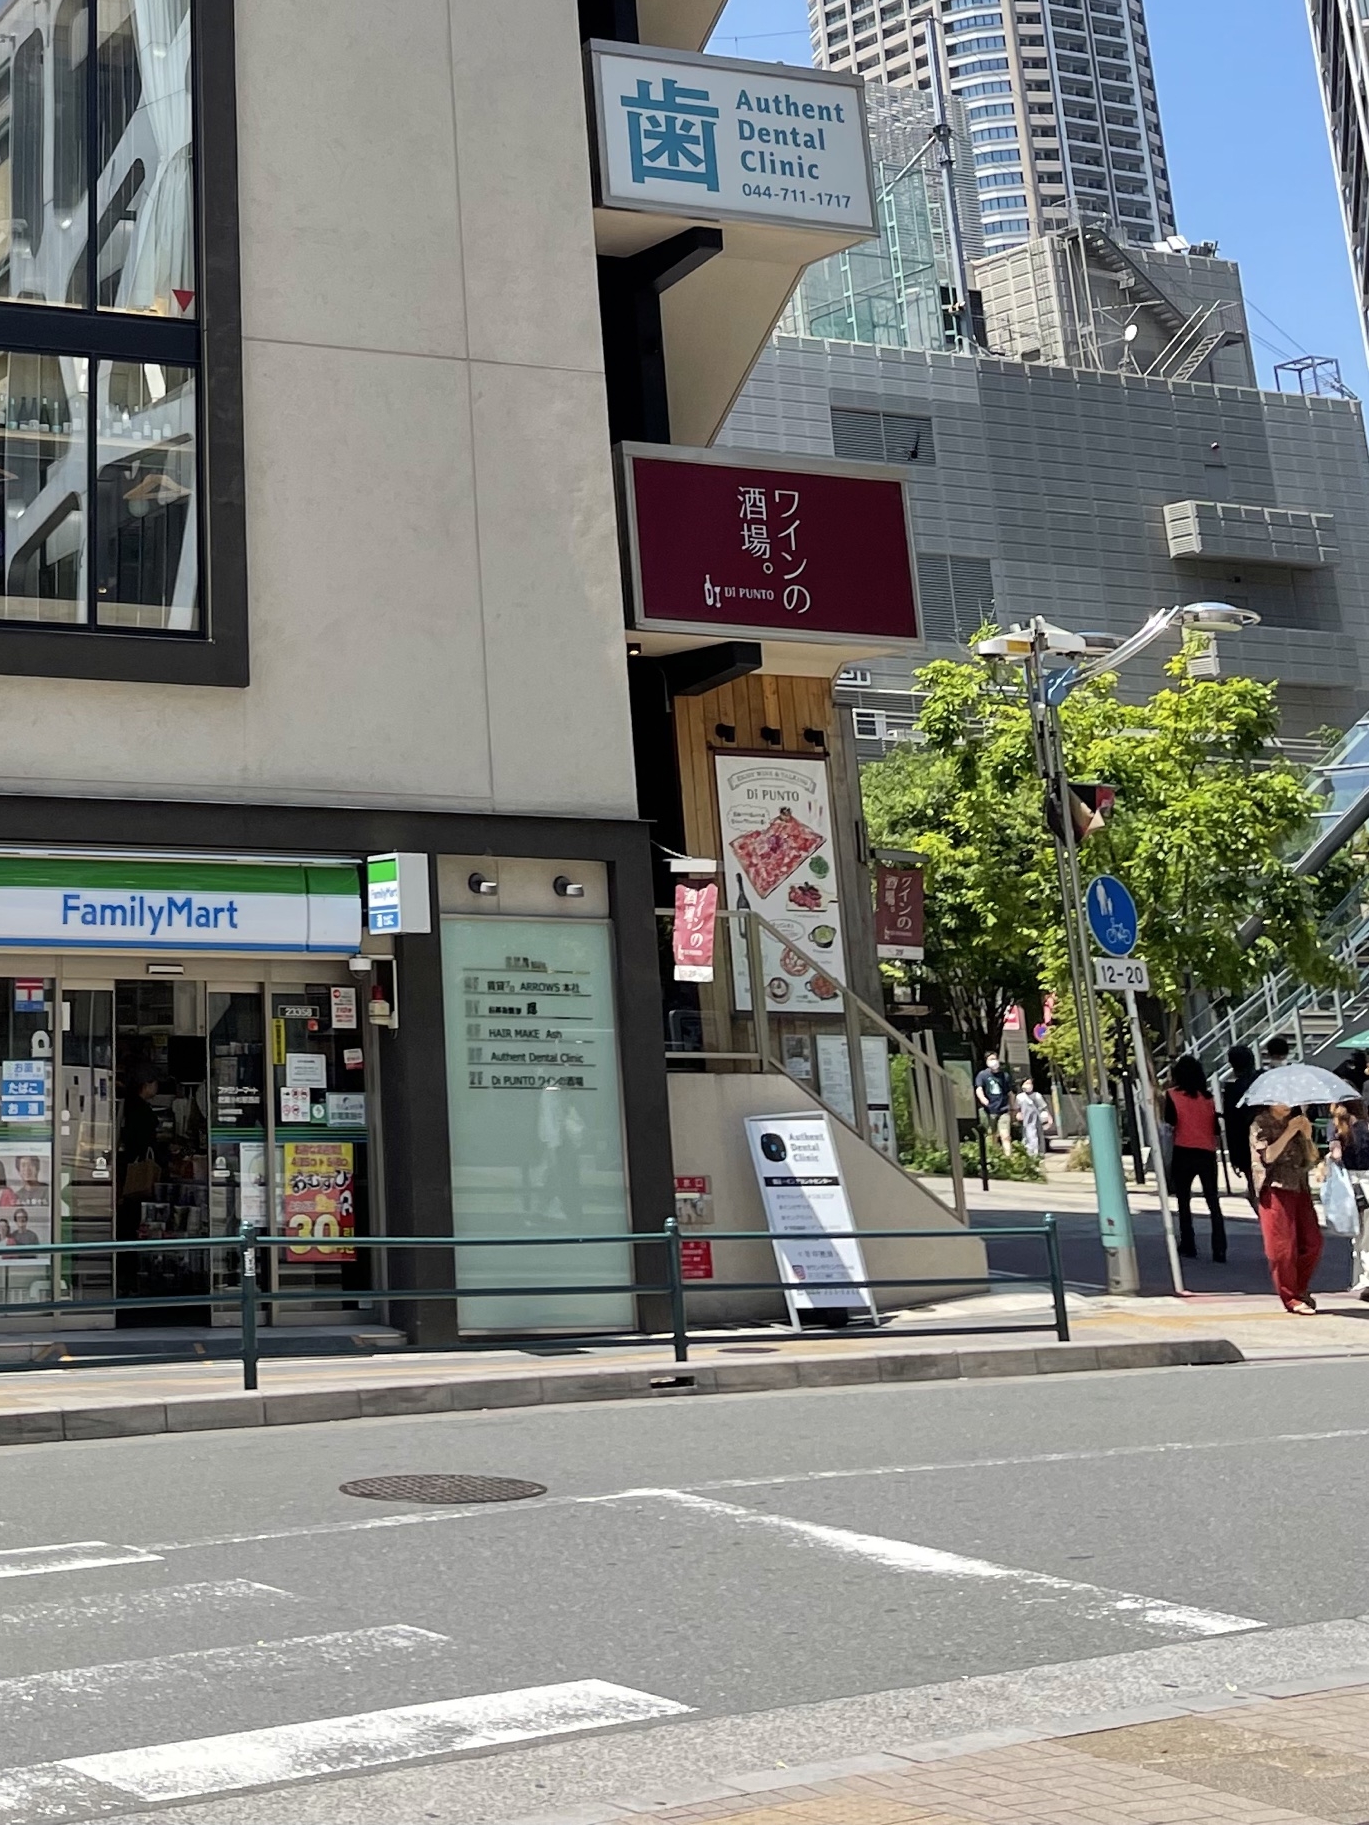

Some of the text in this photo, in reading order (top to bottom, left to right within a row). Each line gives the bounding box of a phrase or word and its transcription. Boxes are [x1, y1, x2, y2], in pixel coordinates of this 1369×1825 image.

[735, 89, 845, 124] Authent
[620, 77, 720, 192] 歯
[737, 119, 826, 151] Dental
[741, 150, 819, 180] Clinic
[742, 182, 851, 209] 044-711-1717
[774, 489, 811, 614] ワインの
[739, 587, 774, 601] PUNTO
[762, 789, 800, 802] PUNTO
[896, 876, 912, 930] ワインの
[62, 893, 239, 936] FamilyMart
[691, 887, 708, 948] ワインの
[1101, 965, 1144, 984] 12-20
[520, 982, 560, 992] ARROWS
[284, 1007, 313, 1017] 23358
[489, 1029, 563, 1039] HAIR MAKE Ash
[491, 1052, 584, 1064] Authent Dental Clinic
[8, 1082, 38, 1094] たばこ
[503, 1076, 535, 1086] PUNTO
[789, 1132, 825, 1141] Authent
[791, 1143, 820, 1152] Dental
[793, 1154, 819, 1162] Clinic
[289, 1214, 339, 1254] 30
